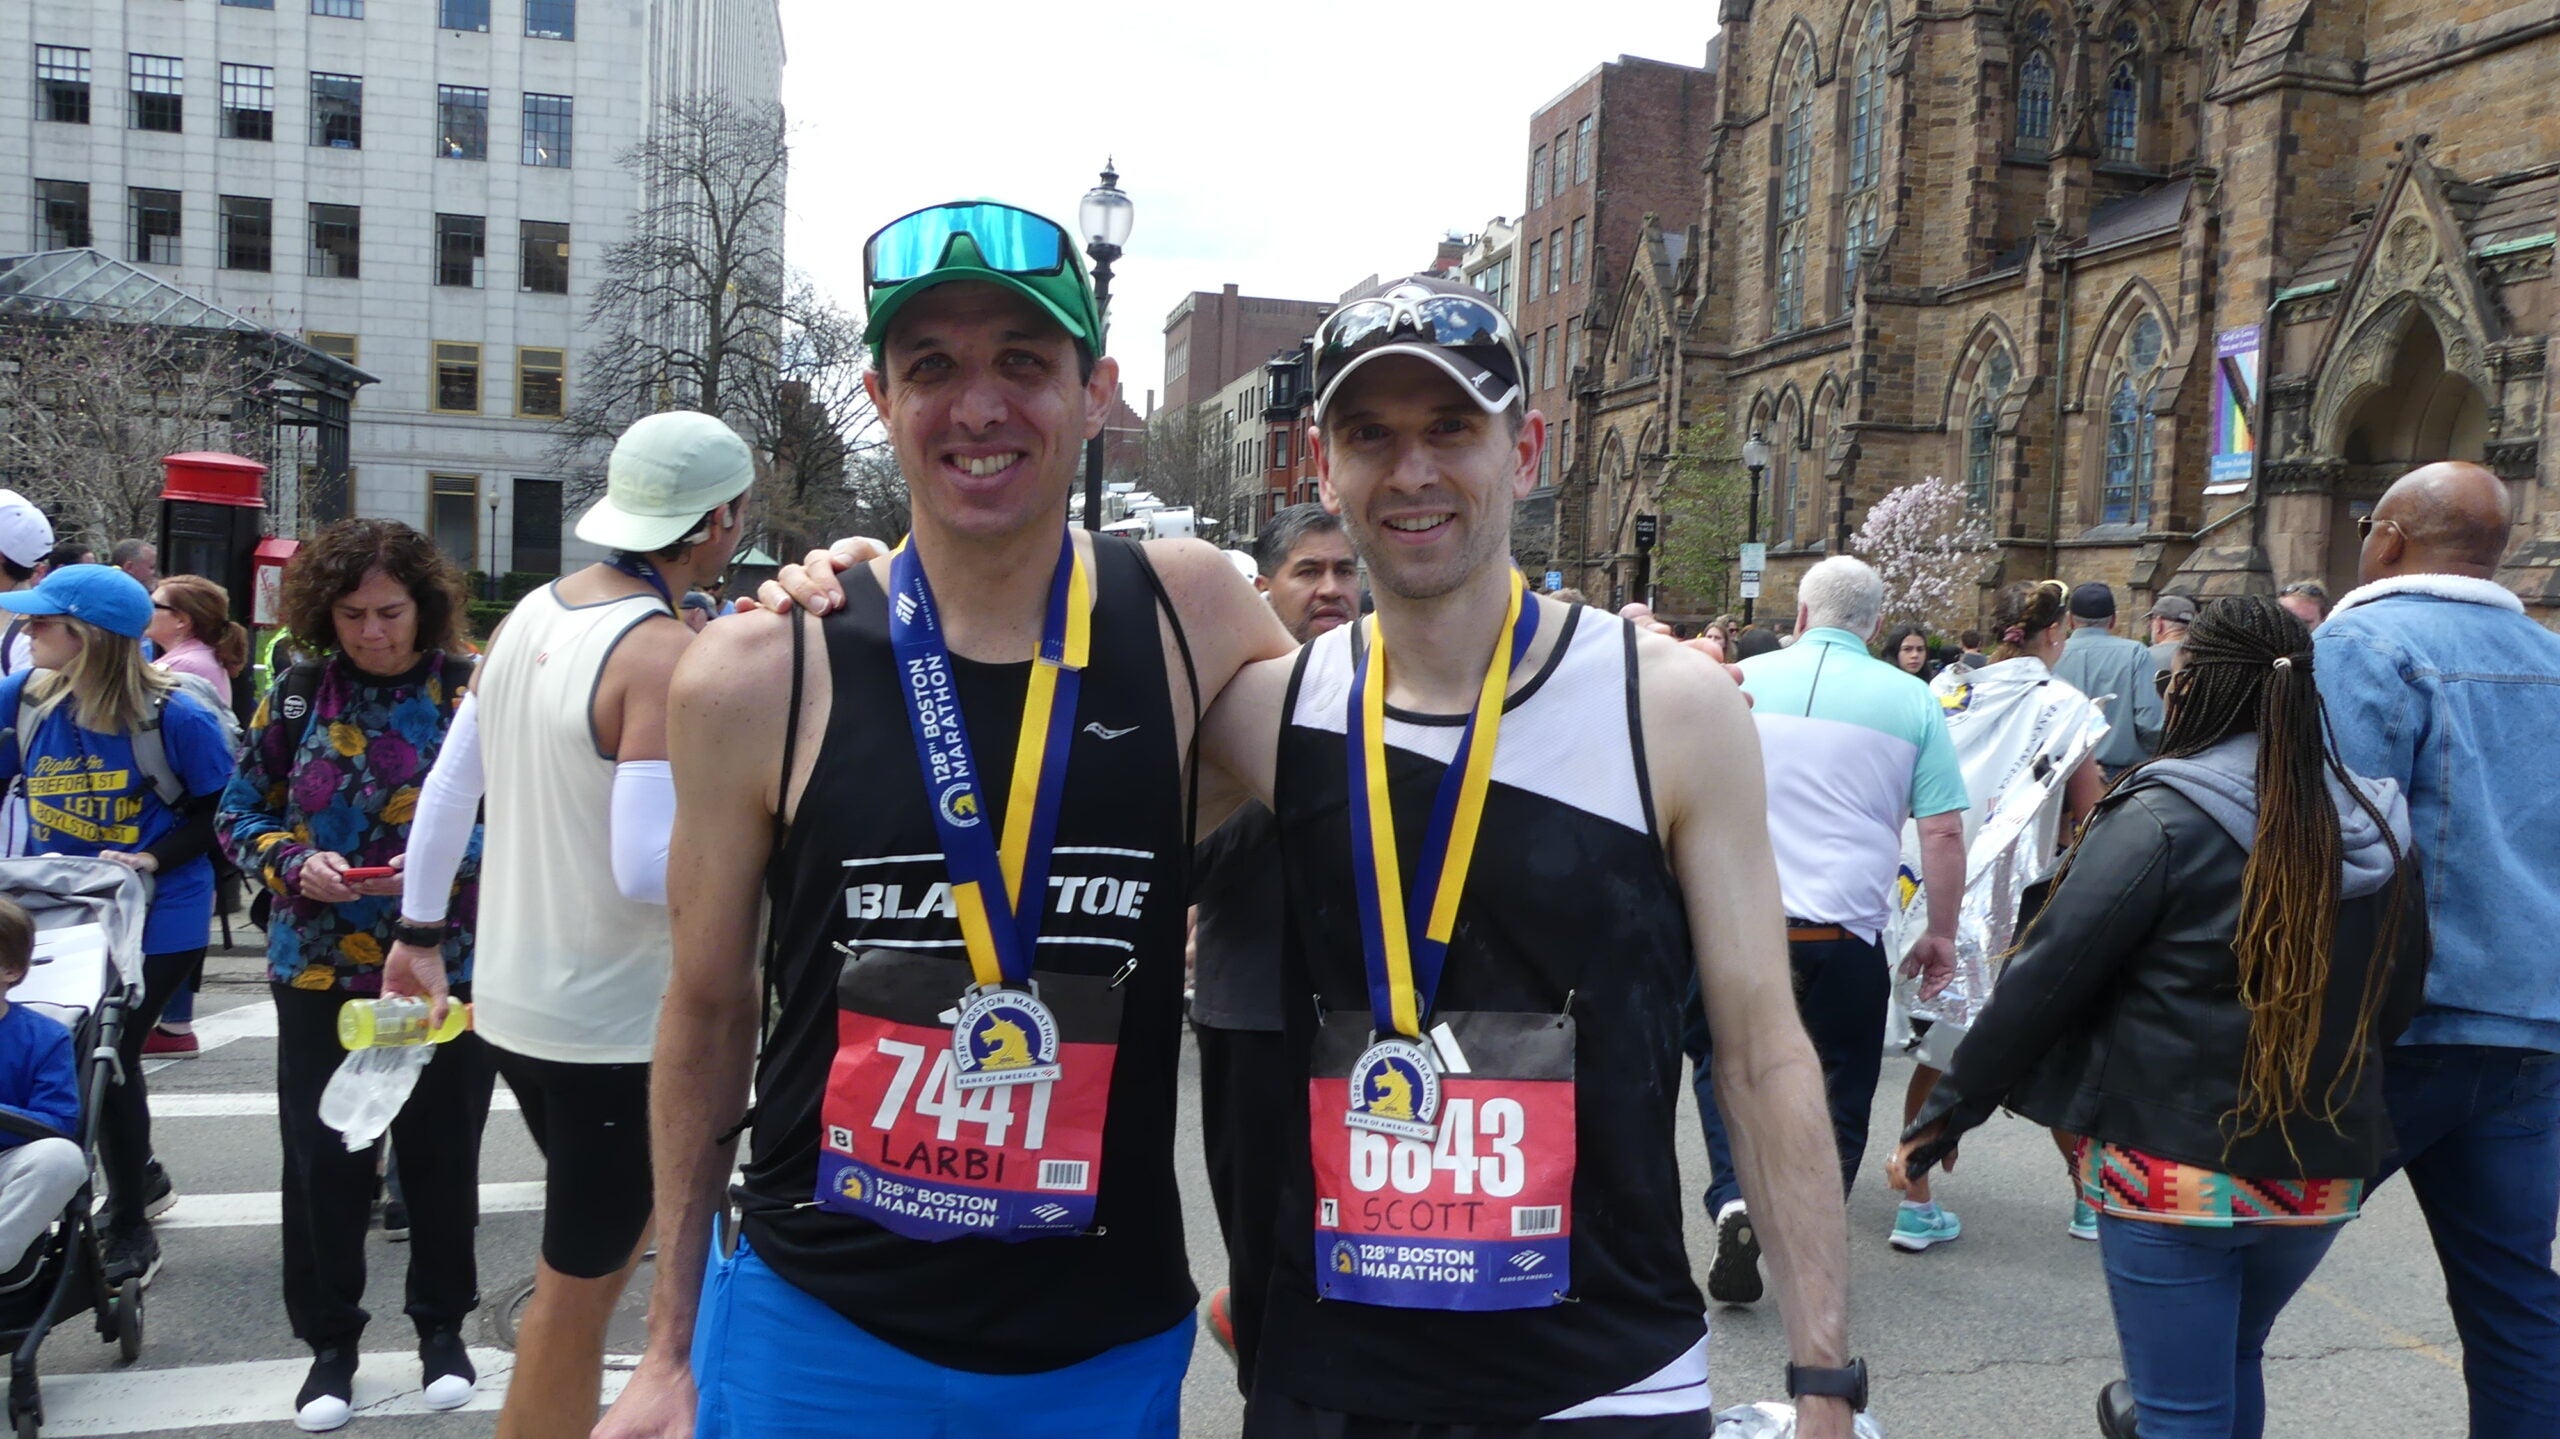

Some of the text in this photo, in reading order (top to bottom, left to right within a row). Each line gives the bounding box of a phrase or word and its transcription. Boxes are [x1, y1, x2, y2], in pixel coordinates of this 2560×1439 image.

[907, 658, 952, 785] 128TH BOSTON
[925, 654, 970, 779] MARATHON
[33, 755, 82, 777] Right
[98, 773, 118, 789] ST
[845, 875, 1151, 920] BLATOE
[961, 996, 1006, 1030] BOSTON
[1012, 997, 1053, 1057] MARATHON
[871, 1037, 1054, 1150] 7441
[1360, 1046, 1401, 1071] BOSTON
[1406, 1049, 1435, 1114] MARATHON
[879, 1133, 1005, 1183] LARBI
[874, 1193, 997, 1228] MARATHON
[875, 1177, 916, 1197] 128TH
[917, 1188, 998, 1213] BOSTON
[1324, 1202, 1334, 1222] 7
[1363, 1196, 1485, 1233] SCOTT
[1359, 1244, 1396, 1261] 128TH
[1397, 1246, 1475, 1266] BOSTON
[1361, 1261, 1478, 1283] MARATHON
